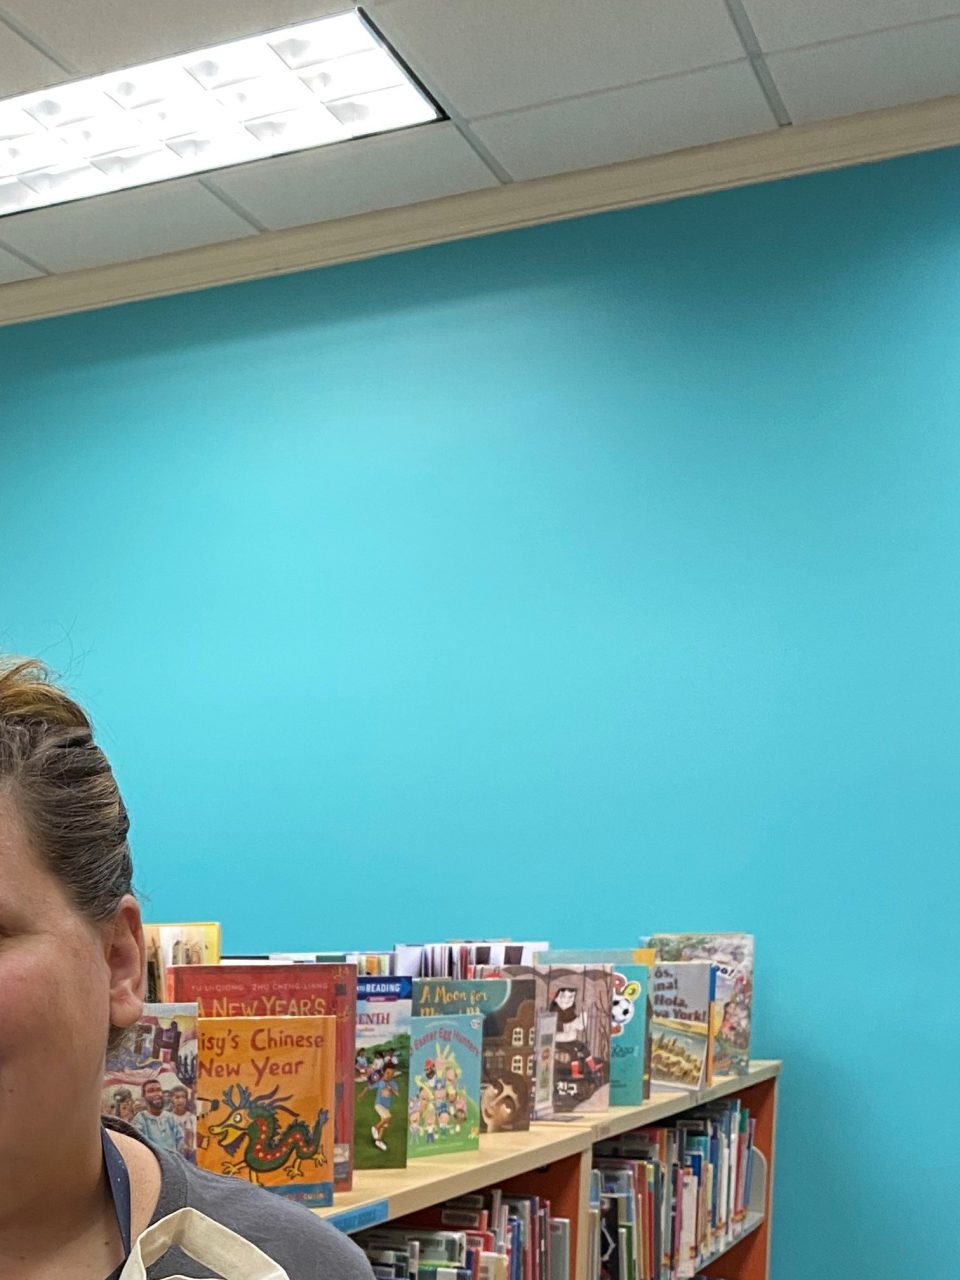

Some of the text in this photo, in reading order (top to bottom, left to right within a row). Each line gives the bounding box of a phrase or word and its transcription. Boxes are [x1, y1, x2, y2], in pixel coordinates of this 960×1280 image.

[365, 983, 401, 993] READING
[419, 985, 488, 1005] A Moon for
[212, 997, 258, 1017] NEW
[261, 994, 327, 1017] YEAR'S
[673, 1008, 707, 1022] York!
[250, 1027, 325, 1052] Chinese
[198, 1056, 304, 1087] New Year
